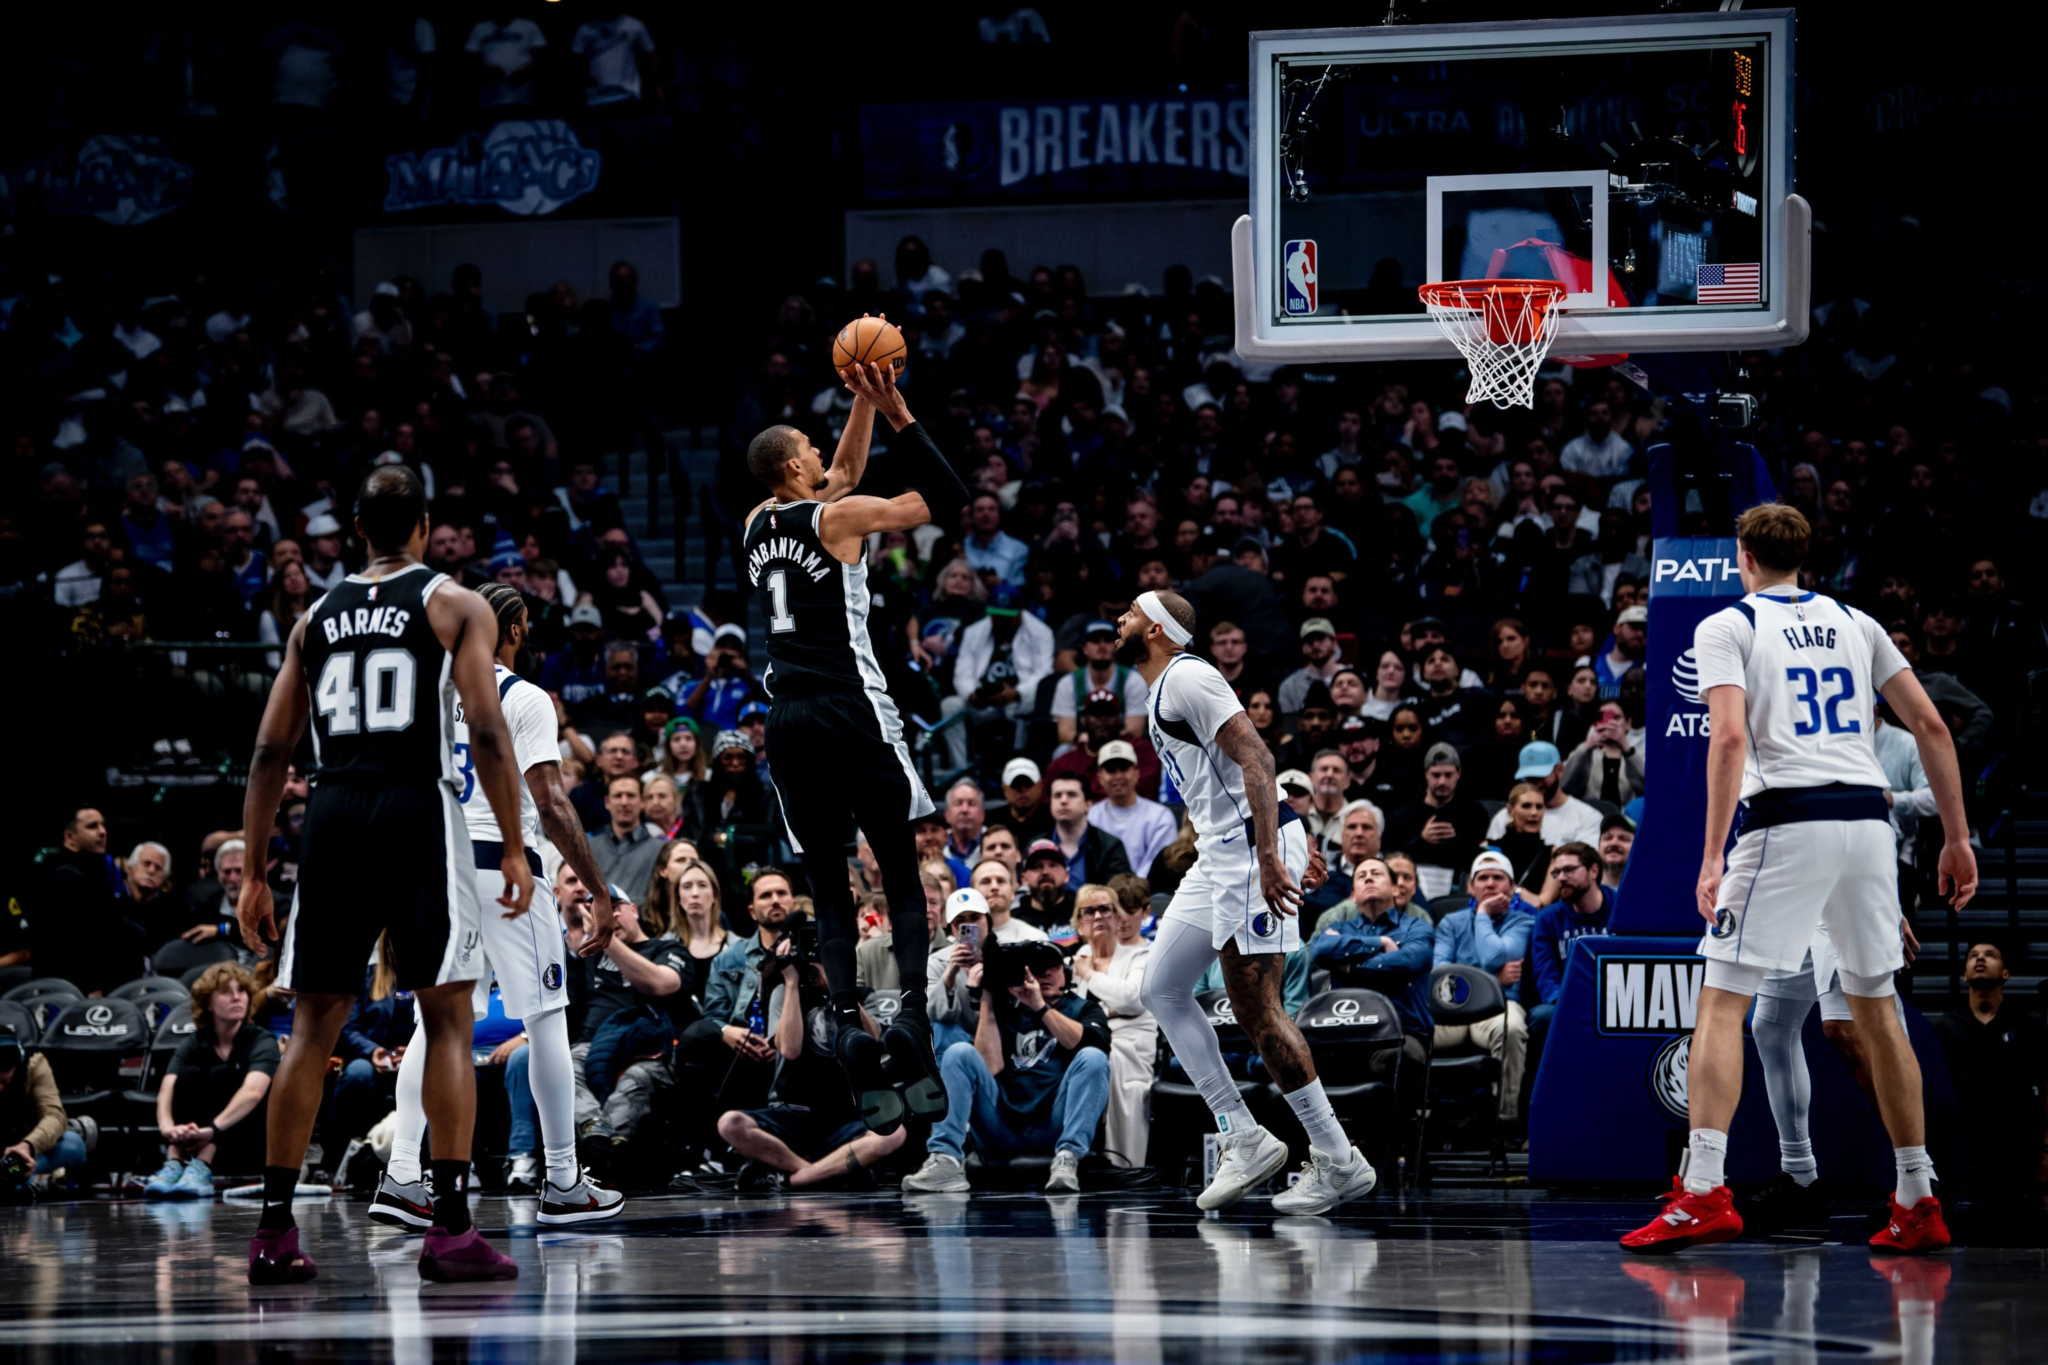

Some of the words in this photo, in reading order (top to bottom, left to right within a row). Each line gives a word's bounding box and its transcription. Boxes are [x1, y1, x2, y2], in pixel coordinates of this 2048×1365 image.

[1000, 101, 1249, 187] BREAKERS
[1289, 297, 1306, 311] NBA
[767, 569, 796, 634] 1
[323, 606, 411, 644] BARNES
[1783, 625, 1836, 650] FLAGG
[315, 648, 417, 736] 40
[1786, 666, 1861, 736] 32
[64, 1023, 128, 1036] LEXUS
[1310, 1014, 1379, 1028] LEXUS
